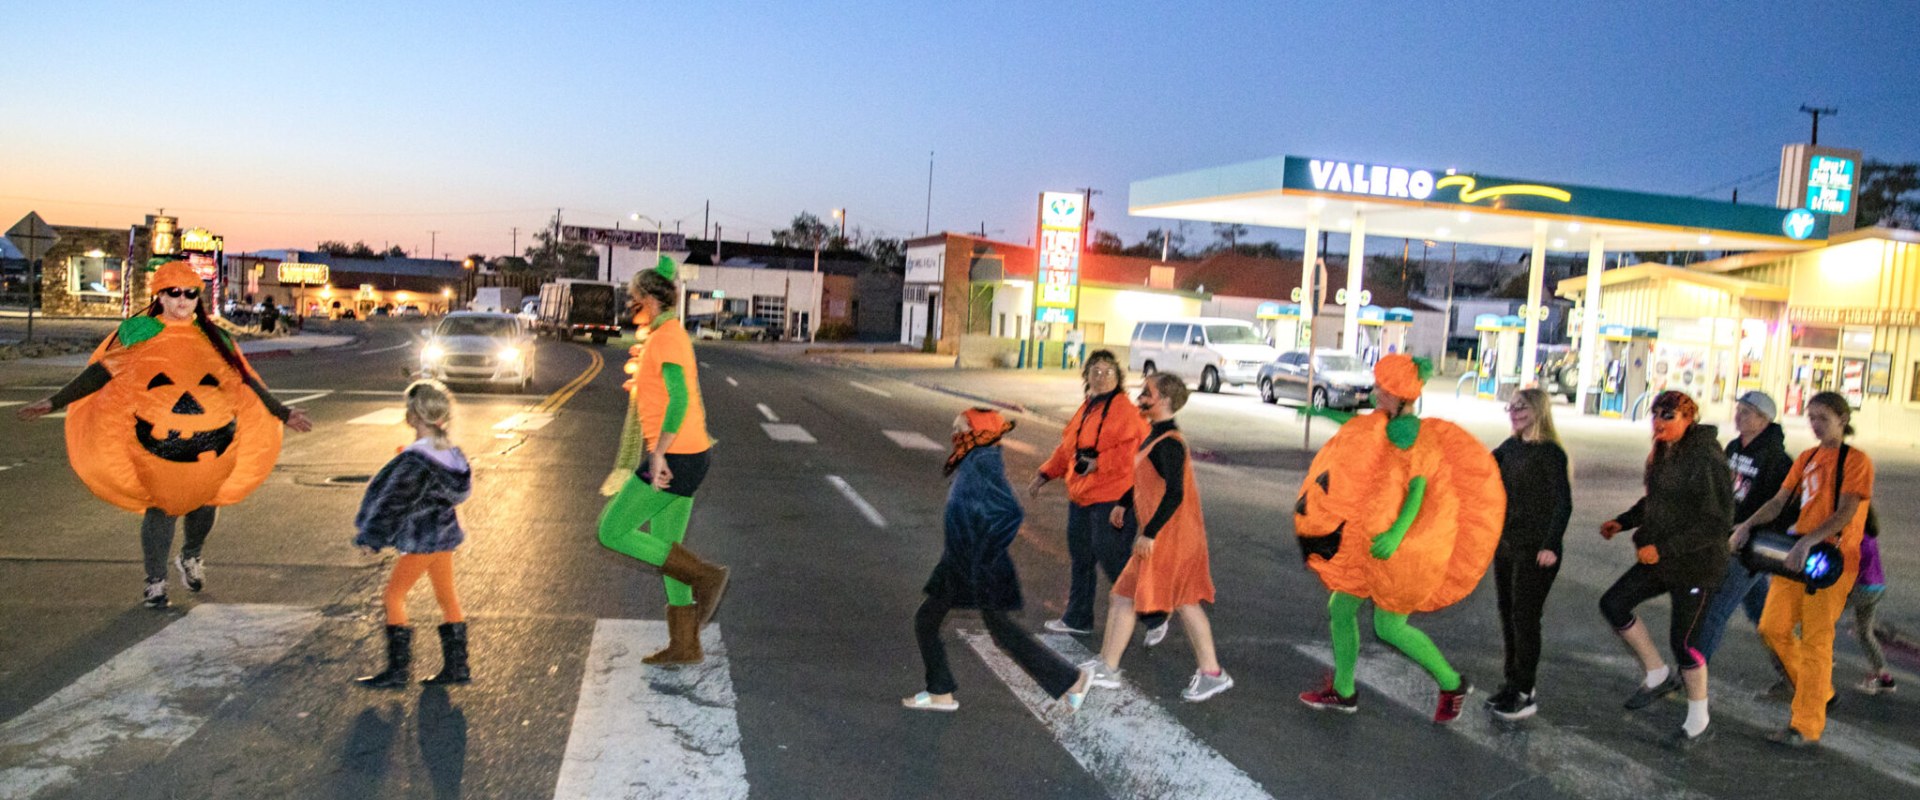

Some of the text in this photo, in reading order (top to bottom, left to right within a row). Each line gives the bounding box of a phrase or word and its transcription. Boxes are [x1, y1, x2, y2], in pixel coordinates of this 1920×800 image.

[1309, 159, 1434, 200] VALERO
[1790, 307, 1839, 322] GROCERIES
[1845, 309, 1881, 325] LIQUOR
